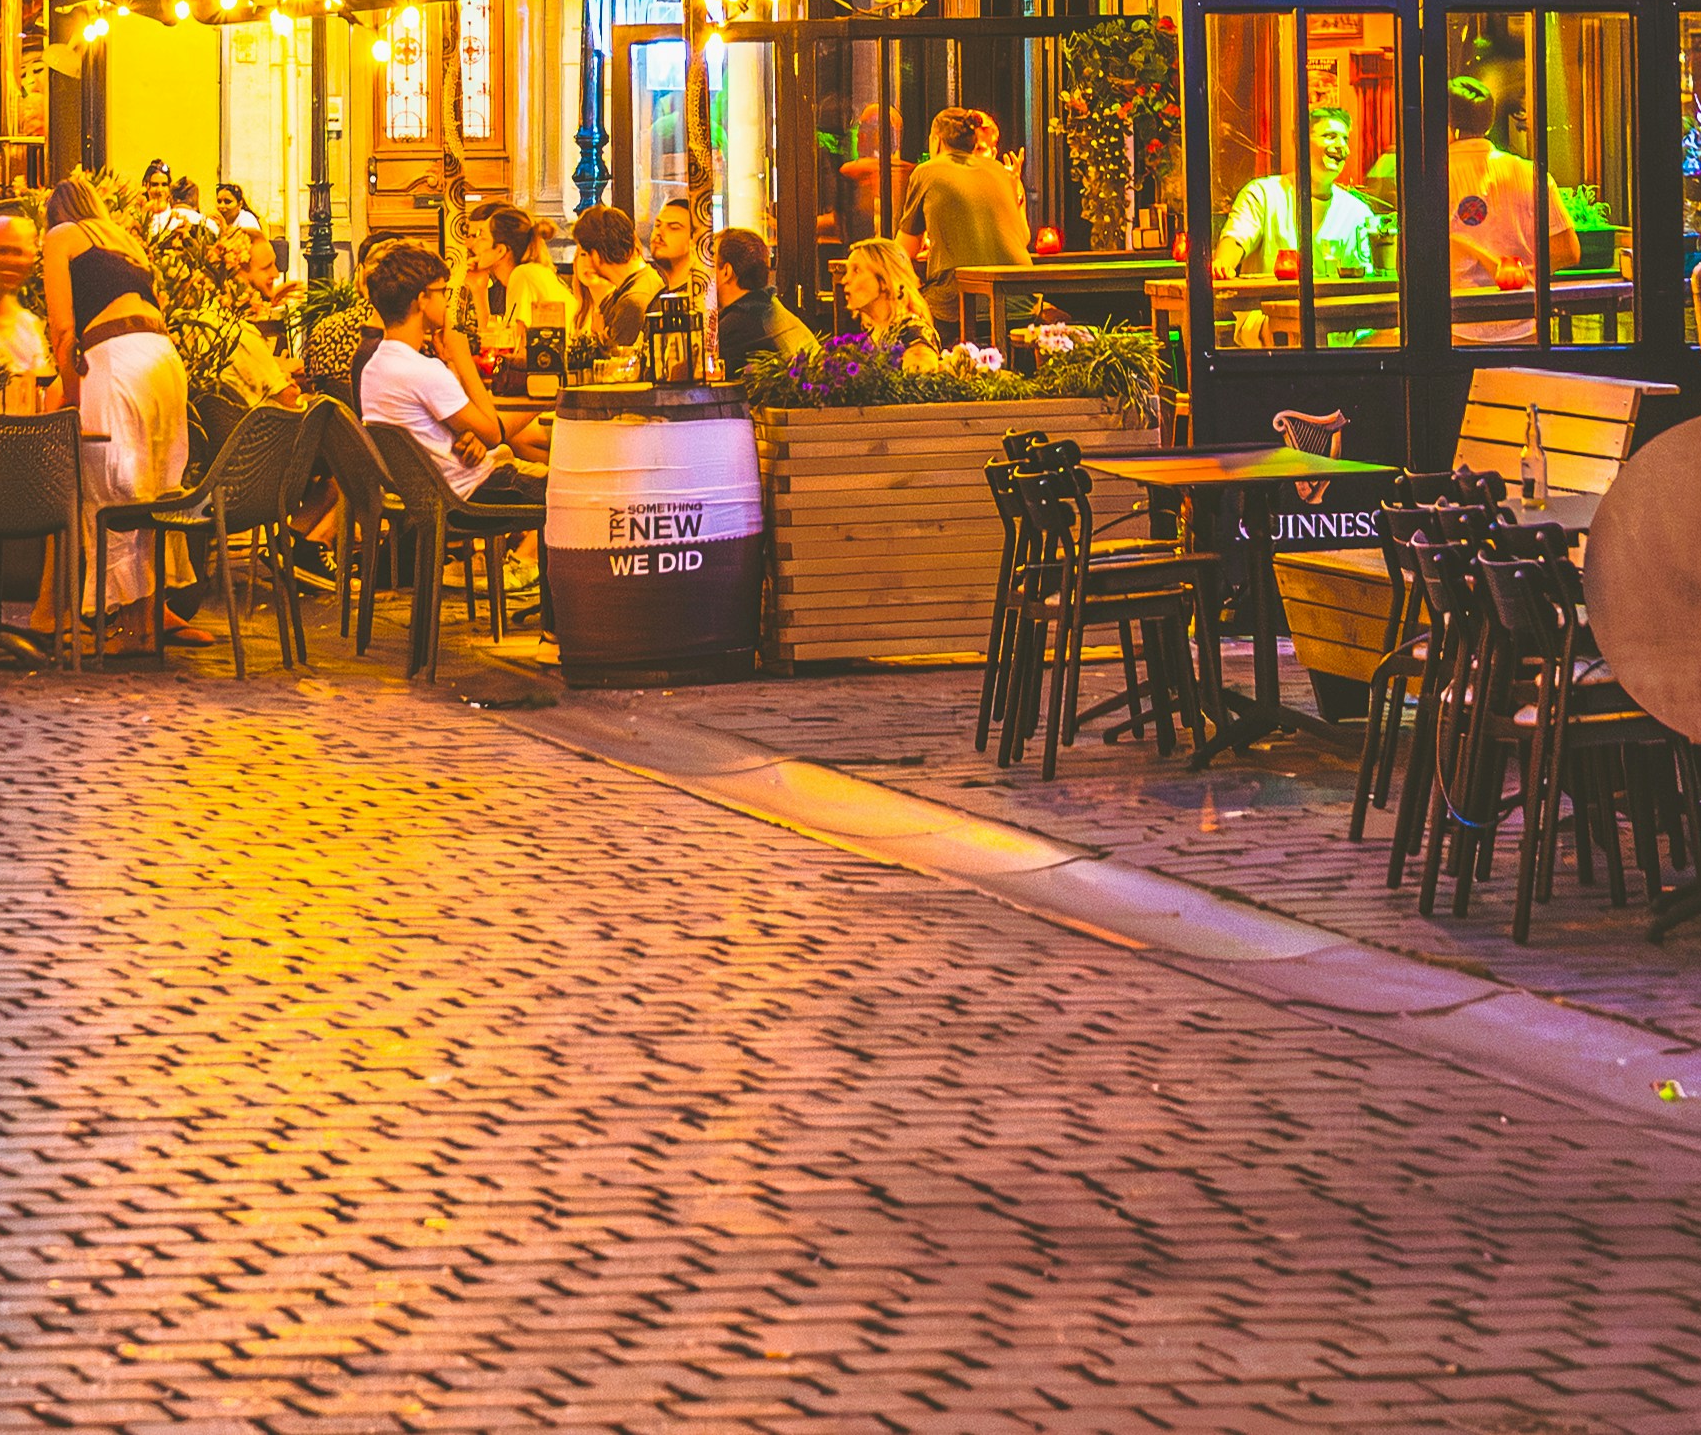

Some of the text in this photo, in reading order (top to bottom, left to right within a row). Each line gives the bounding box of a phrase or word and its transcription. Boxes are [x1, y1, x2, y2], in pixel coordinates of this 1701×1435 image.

[627, 502, 703, 515] SOMETHING
[609, 507, 626, 543] TRY
[629, 514, 703, 542] NEW
[609, 550, 703, 577] WE DID
